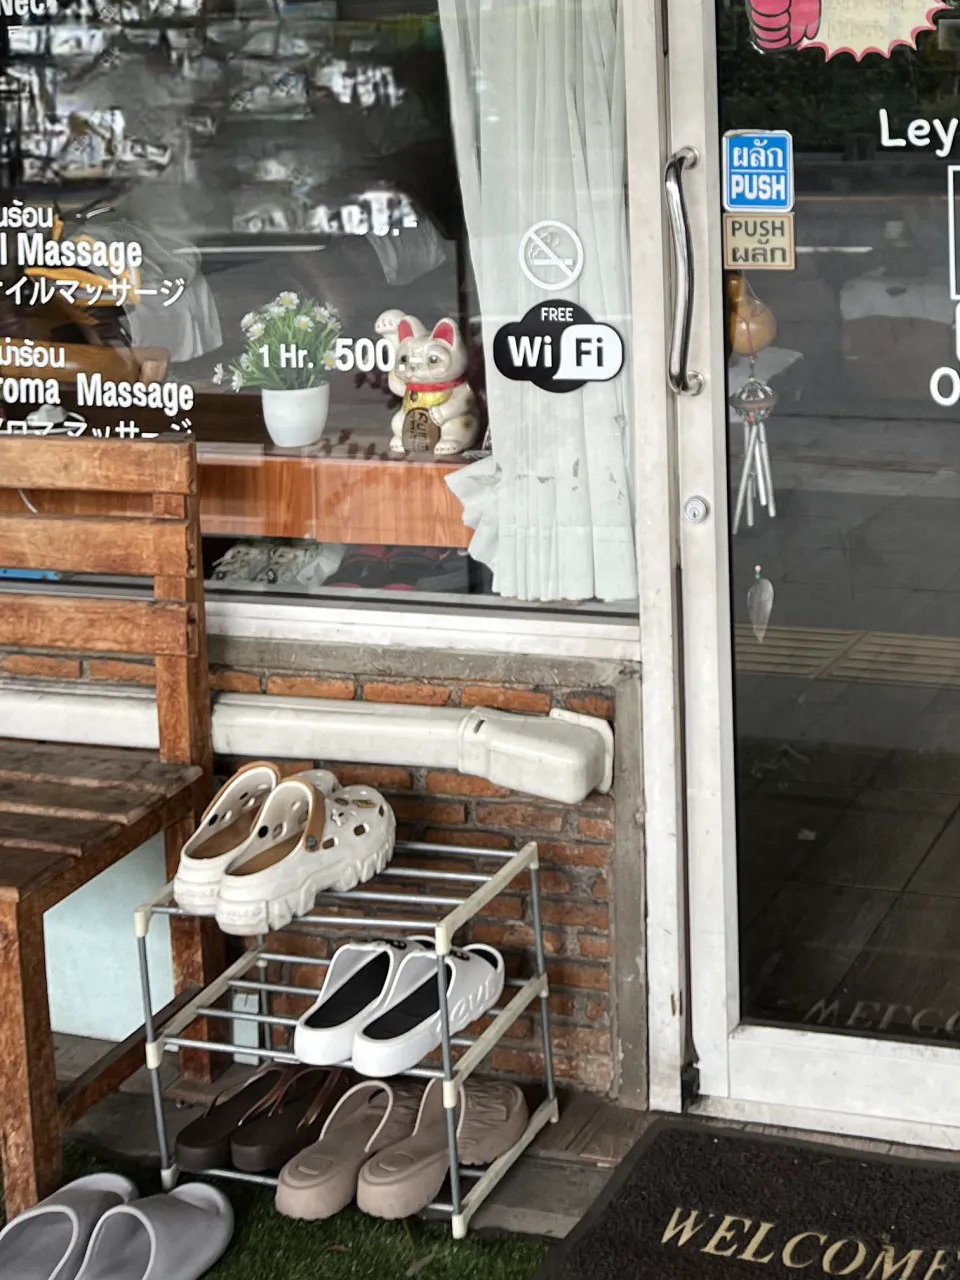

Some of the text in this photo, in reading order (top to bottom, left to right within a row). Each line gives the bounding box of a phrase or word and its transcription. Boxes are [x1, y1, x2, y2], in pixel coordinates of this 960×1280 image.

[733, 138, 783, 168] ผลัก
[731, 174, 786, 200] PUSH
[732, 220, 785, 237] PUSH
[17, 232, 143, 275] Massage
[732, 238, 787, 263] ผลัก
[0, 275, 186, 308] イルマッサージ
[541, 307, 574, 322] FREE
[259, 344, 270, 368] 1
[279, 344, 314, 368] Hr.
[77, 372, 194, 417] Massage
